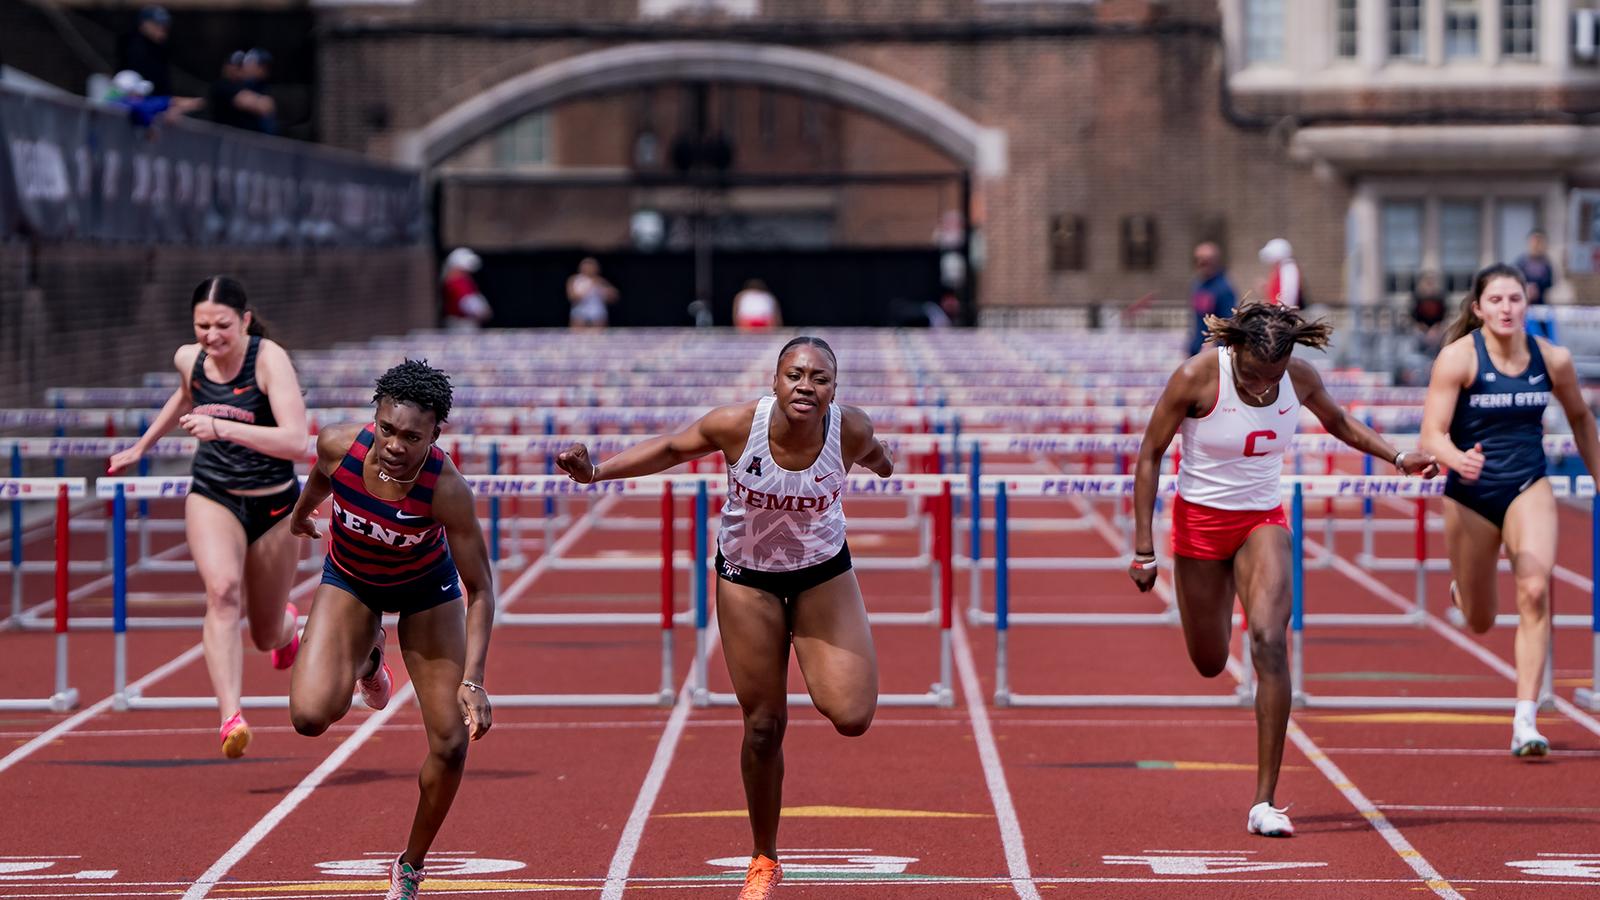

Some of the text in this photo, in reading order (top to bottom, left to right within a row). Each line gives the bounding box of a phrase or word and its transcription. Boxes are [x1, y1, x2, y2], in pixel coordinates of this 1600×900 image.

[1469, 394, 1513, 408] PENN
[1243, 429, 1277, 458] C
[543, 480, 625, 493] RELAYS
[1042, 480, 1100, 493] PENN
[1339, 481, 1398, 493] PENN
